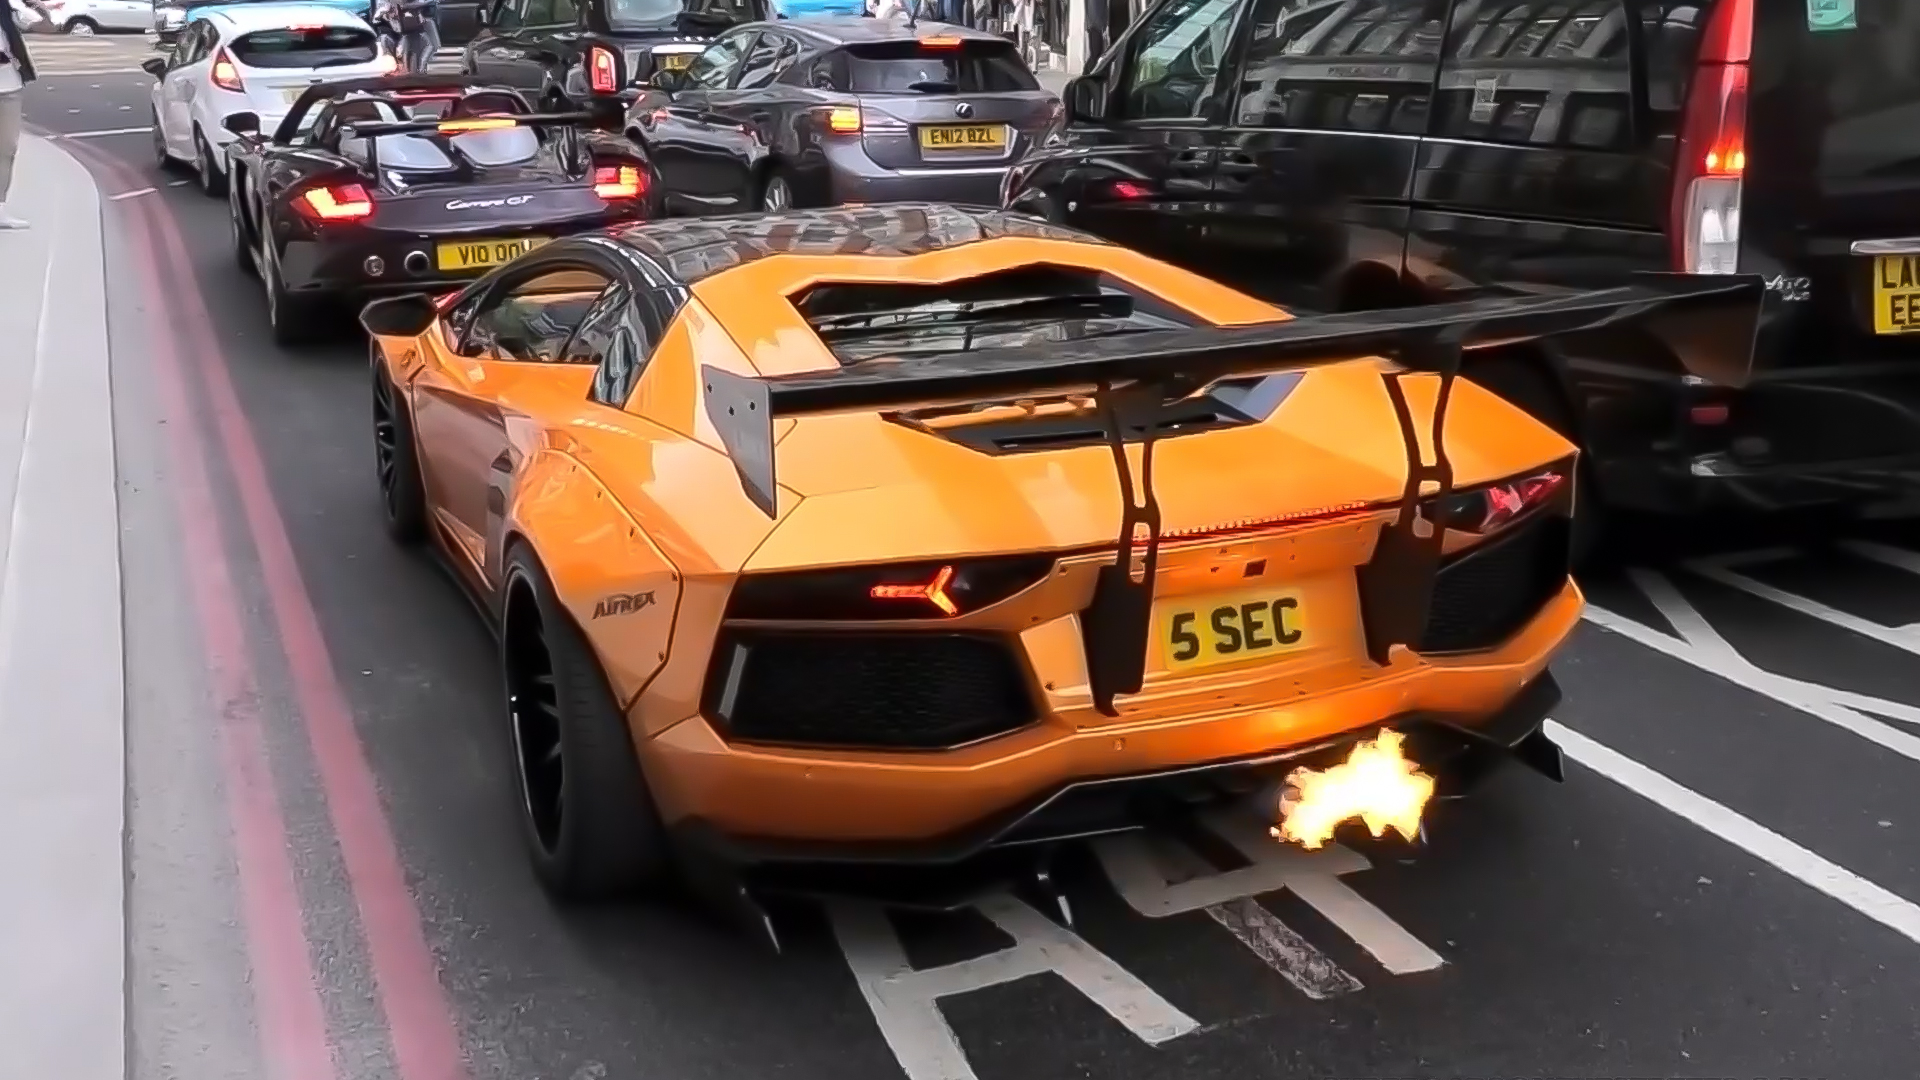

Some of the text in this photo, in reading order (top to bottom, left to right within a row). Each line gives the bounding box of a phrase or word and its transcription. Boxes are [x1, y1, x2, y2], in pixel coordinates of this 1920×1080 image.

[930, 129, 964, 144] EN12
[506, 193, 536, 206] GT
[458, 245, 490, 266] V10
[1170, 596, 1303, 662] 5 SEC
